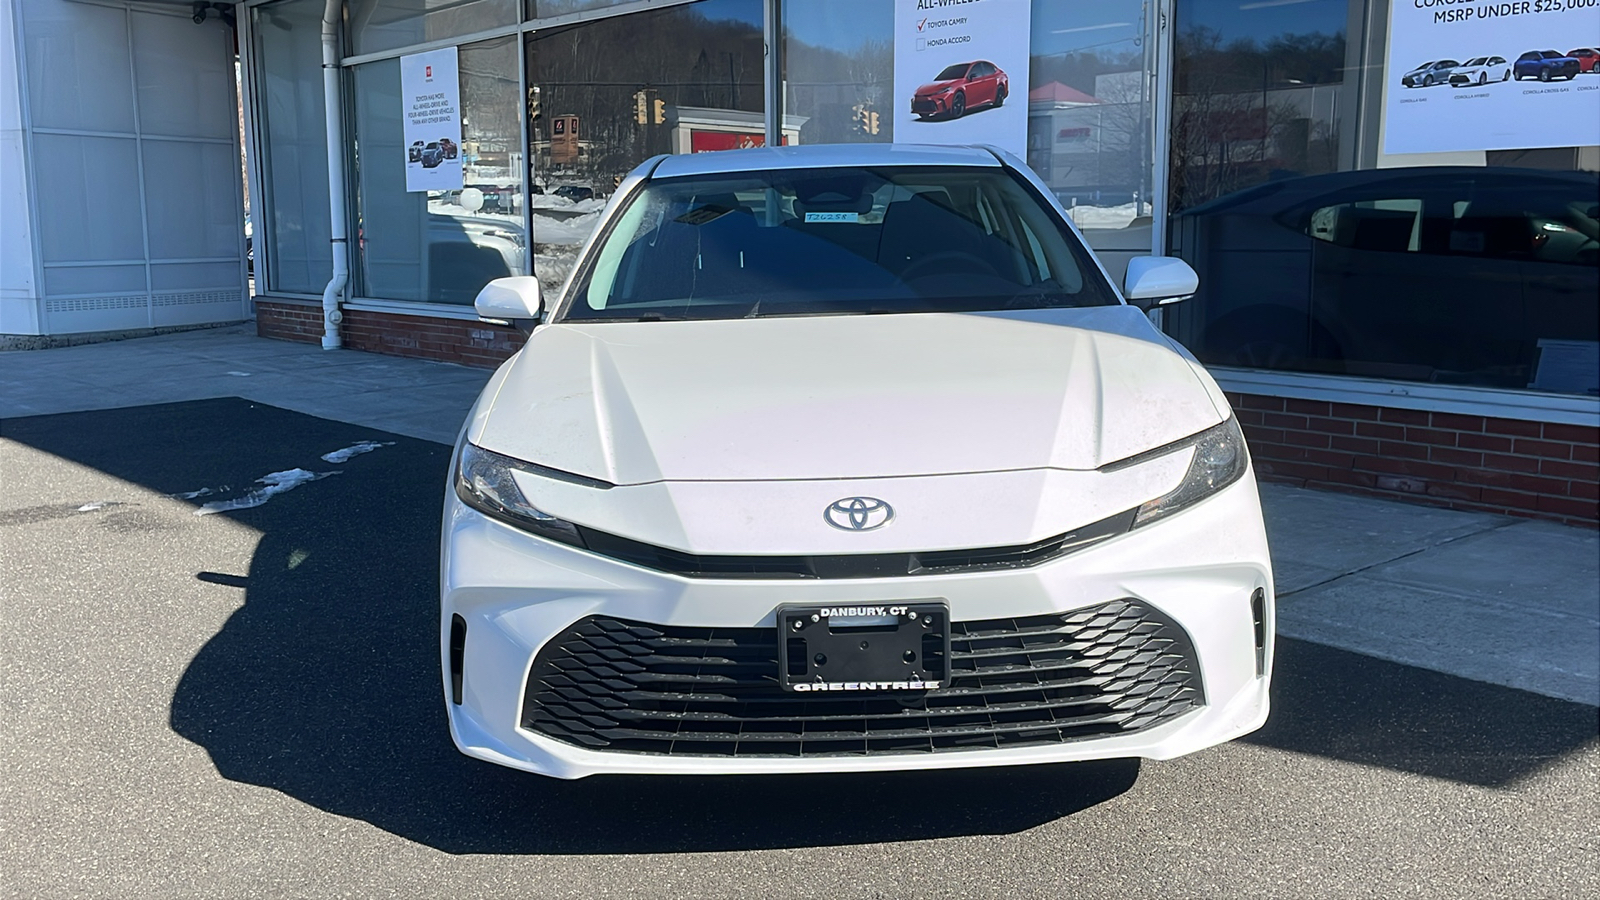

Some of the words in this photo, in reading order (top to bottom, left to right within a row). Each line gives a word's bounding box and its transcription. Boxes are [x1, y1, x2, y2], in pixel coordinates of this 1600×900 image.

[917, 0, 973, 10] ALL-WH
[1434, 8, 1474, 24] MSRP
[1477, 1, 1530, 19] UNDER
[821, 607, 886, 617] DANBURY,
[889, 606, 908, 616] CT
[794, 682, 940, 691] GREENTREE
